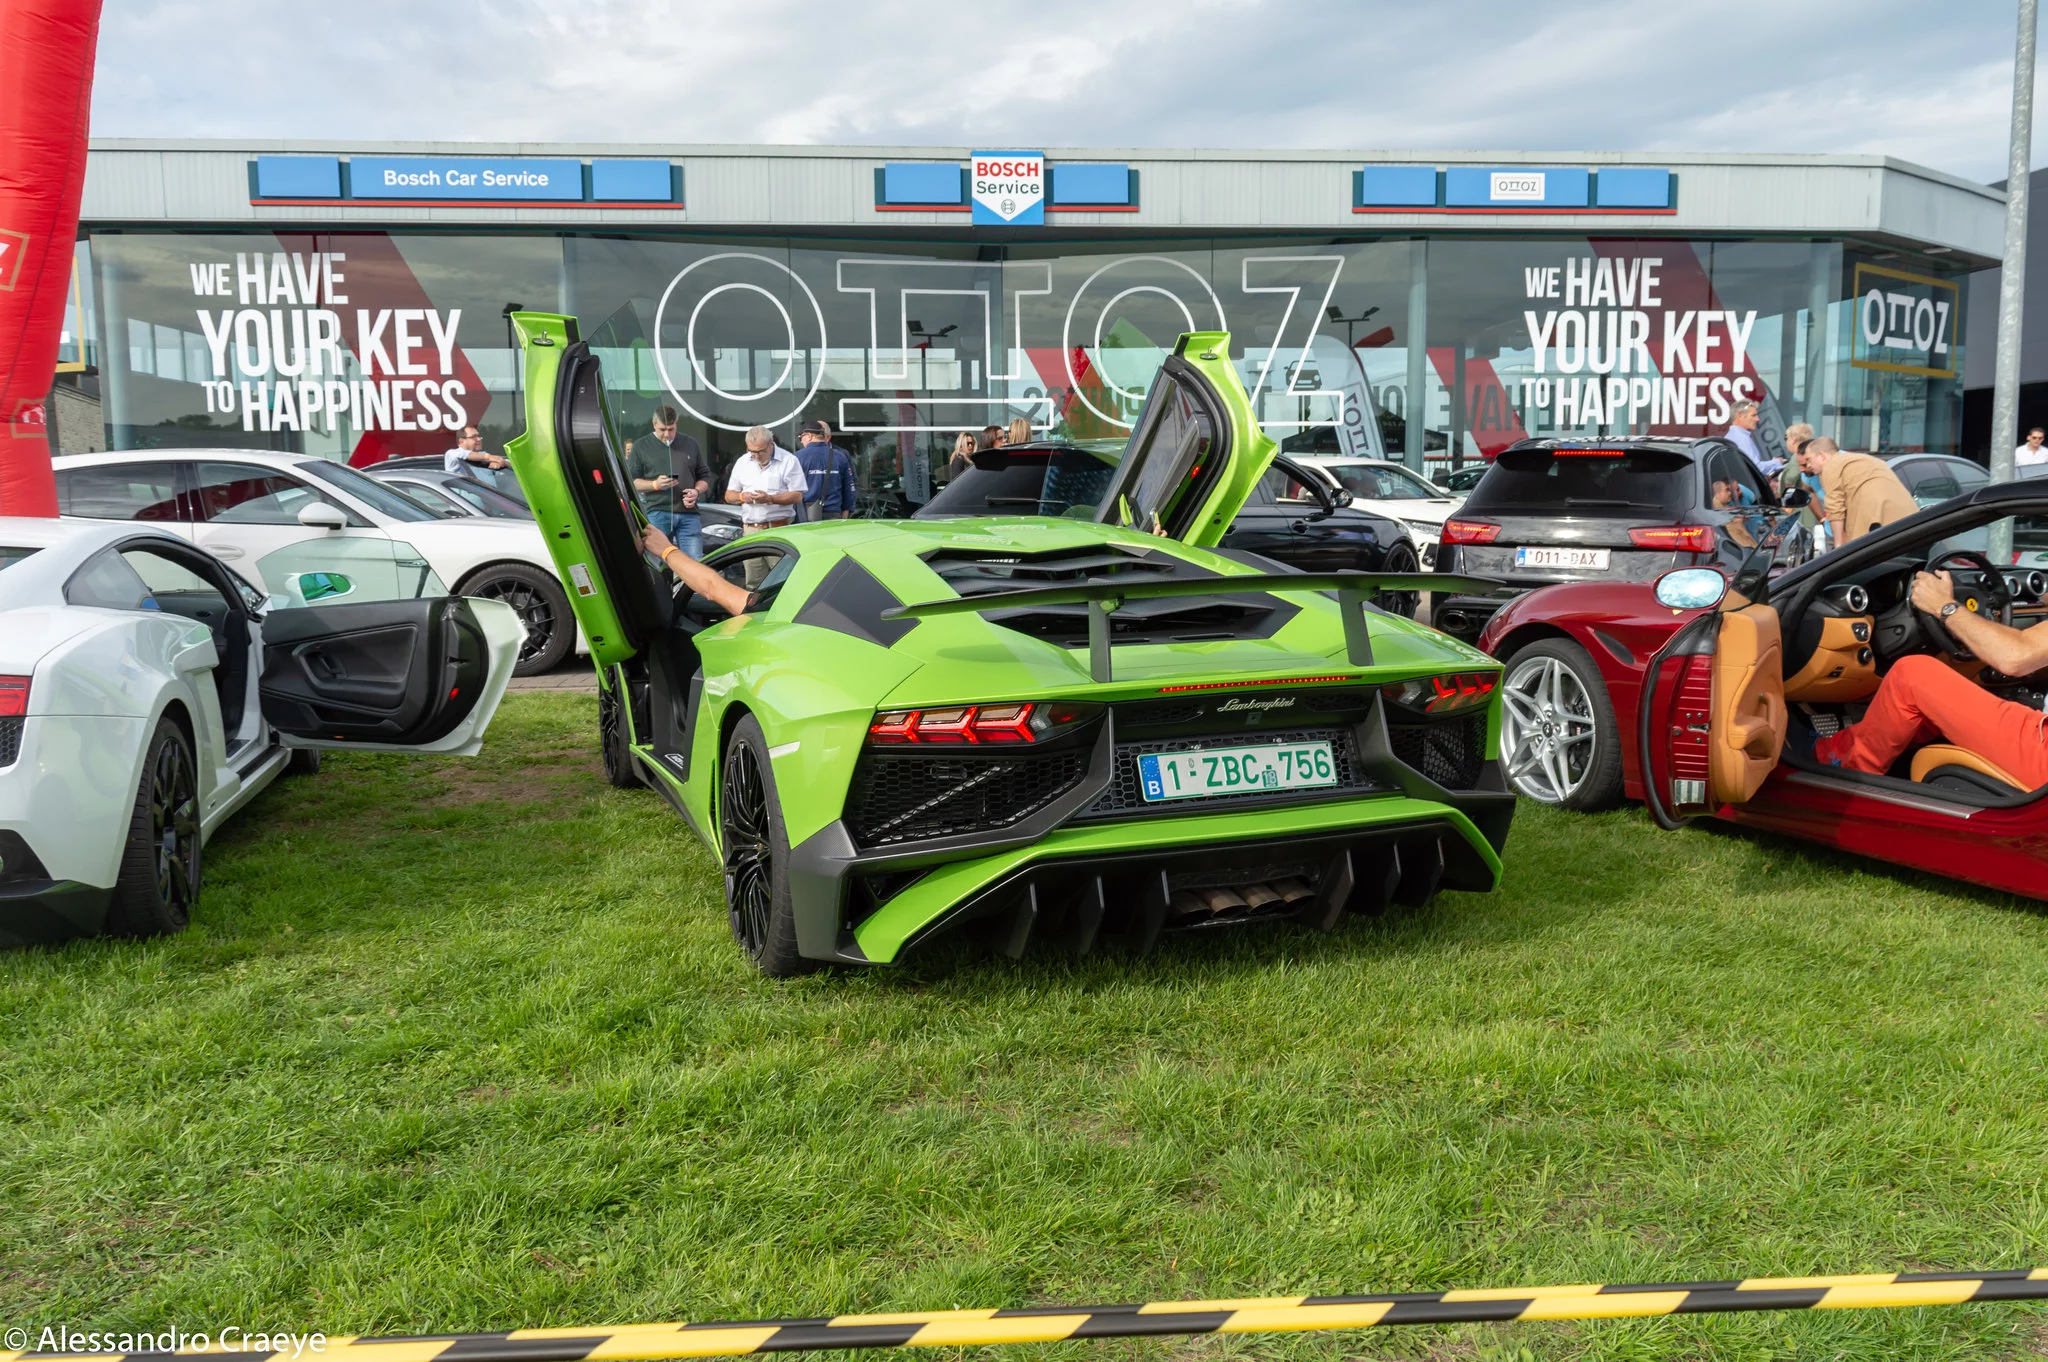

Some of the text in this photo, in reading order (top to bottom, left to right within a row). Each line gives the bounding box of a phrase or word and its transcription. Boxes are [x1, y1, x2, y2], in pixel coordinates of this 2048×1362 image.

[384, 170, 549, 186] Bosch Car Service
[976, 180, 1040, 194] Service
[977, 162, 1039, 177] BOSCH
[1498, 181, 1537, 191] OTTOZ
[190, 253, 349, 304] WE HAVE
[1525, 257, 1663, 307] WE HAVE
[1863, 288, 1950, 354] OTTOZ
[196, 309, 462, 377] YOUR KEY
[654, 252, 1345, 431] OTTOZ
[1524, 310, 1758, 374] YOUR KEY
[201, 380, 468, 432] TO HAPPINESS
[1522, 378, 1550, 407] TO
[1217, 697, 1296, 712] Lamborghini
[1147, 780, 1161, 796] B
